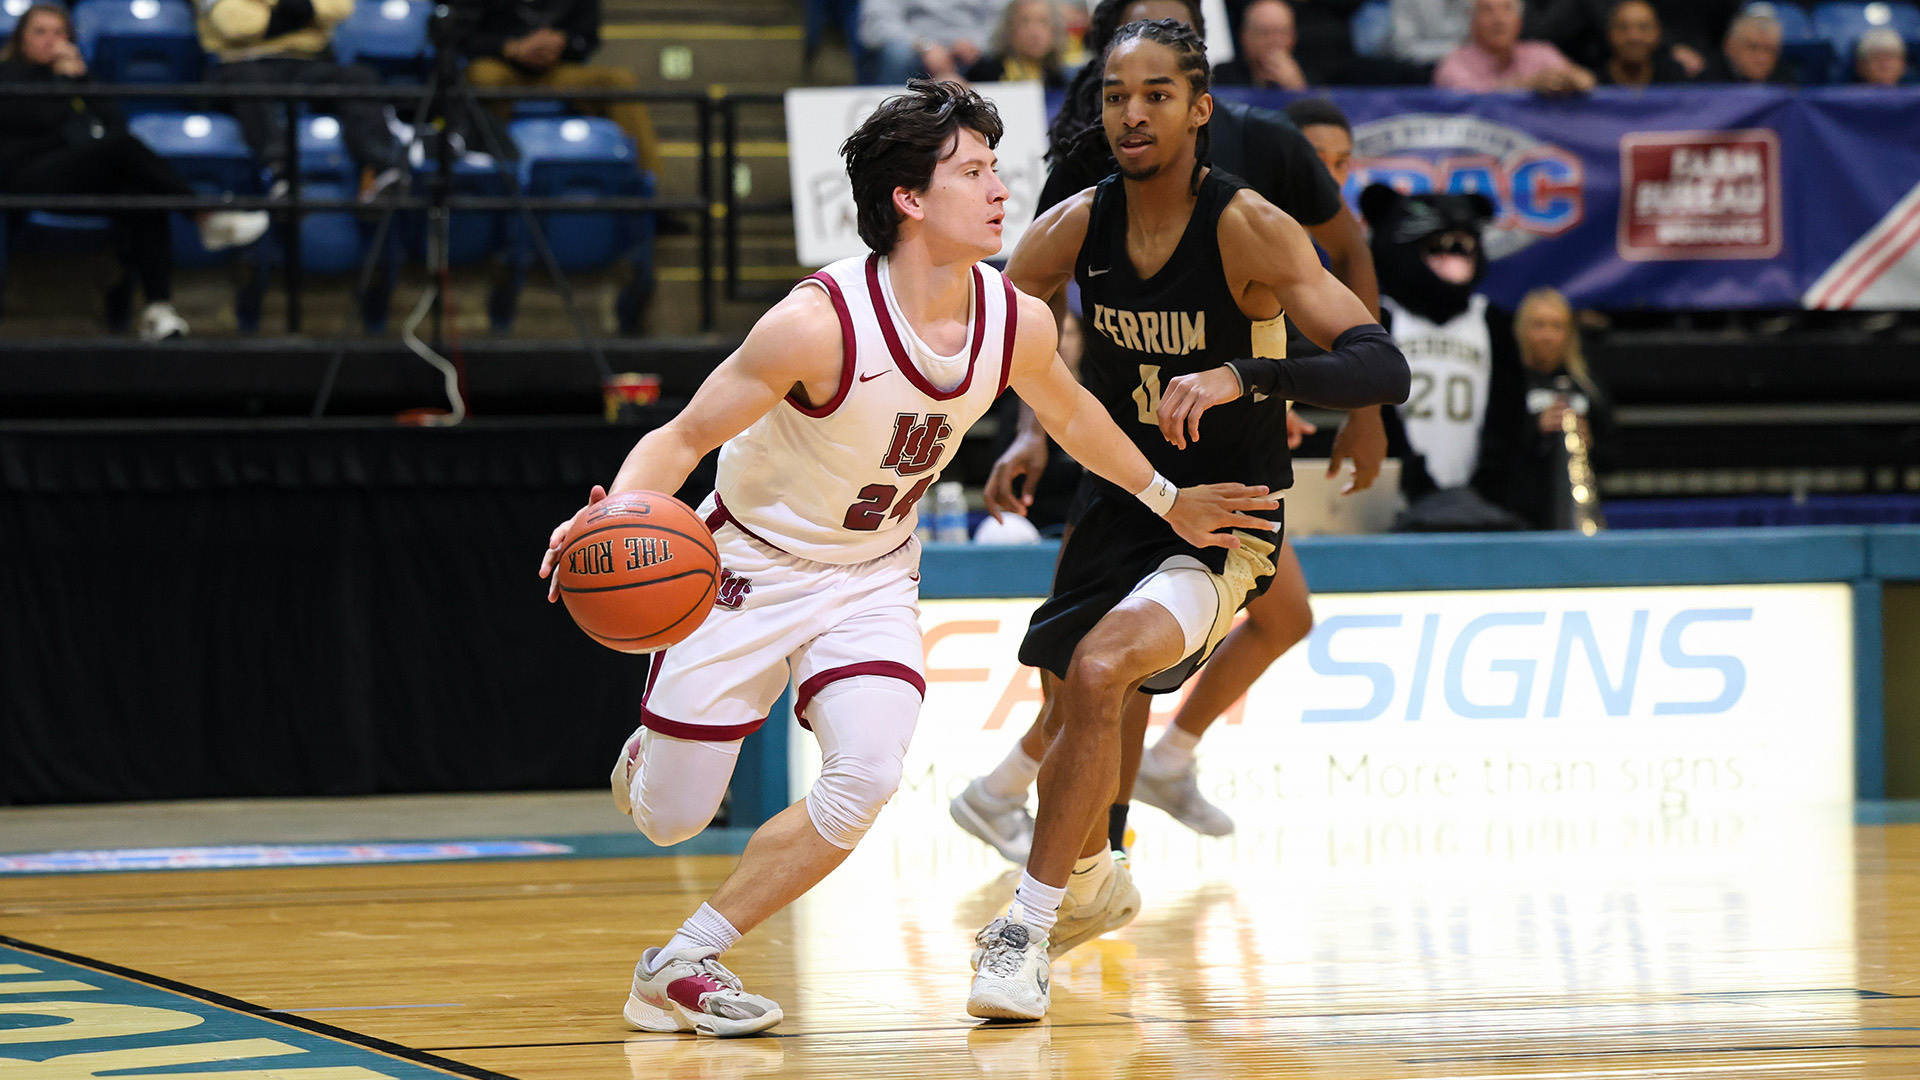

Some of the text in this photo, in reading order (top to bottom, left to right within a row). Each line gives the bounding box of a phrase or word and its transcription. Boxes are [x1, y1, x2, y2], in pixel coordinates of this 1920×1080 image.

[1093, 303, 1207, 356] FERRUM
[1405, 372, 1474, 422] 20
[842, 474, 934, 531] 24
[568, 536, 675, 575] THE ROCK
[1327, 753, 1458, 798] More
[1484, 748, 1598, 796] than
